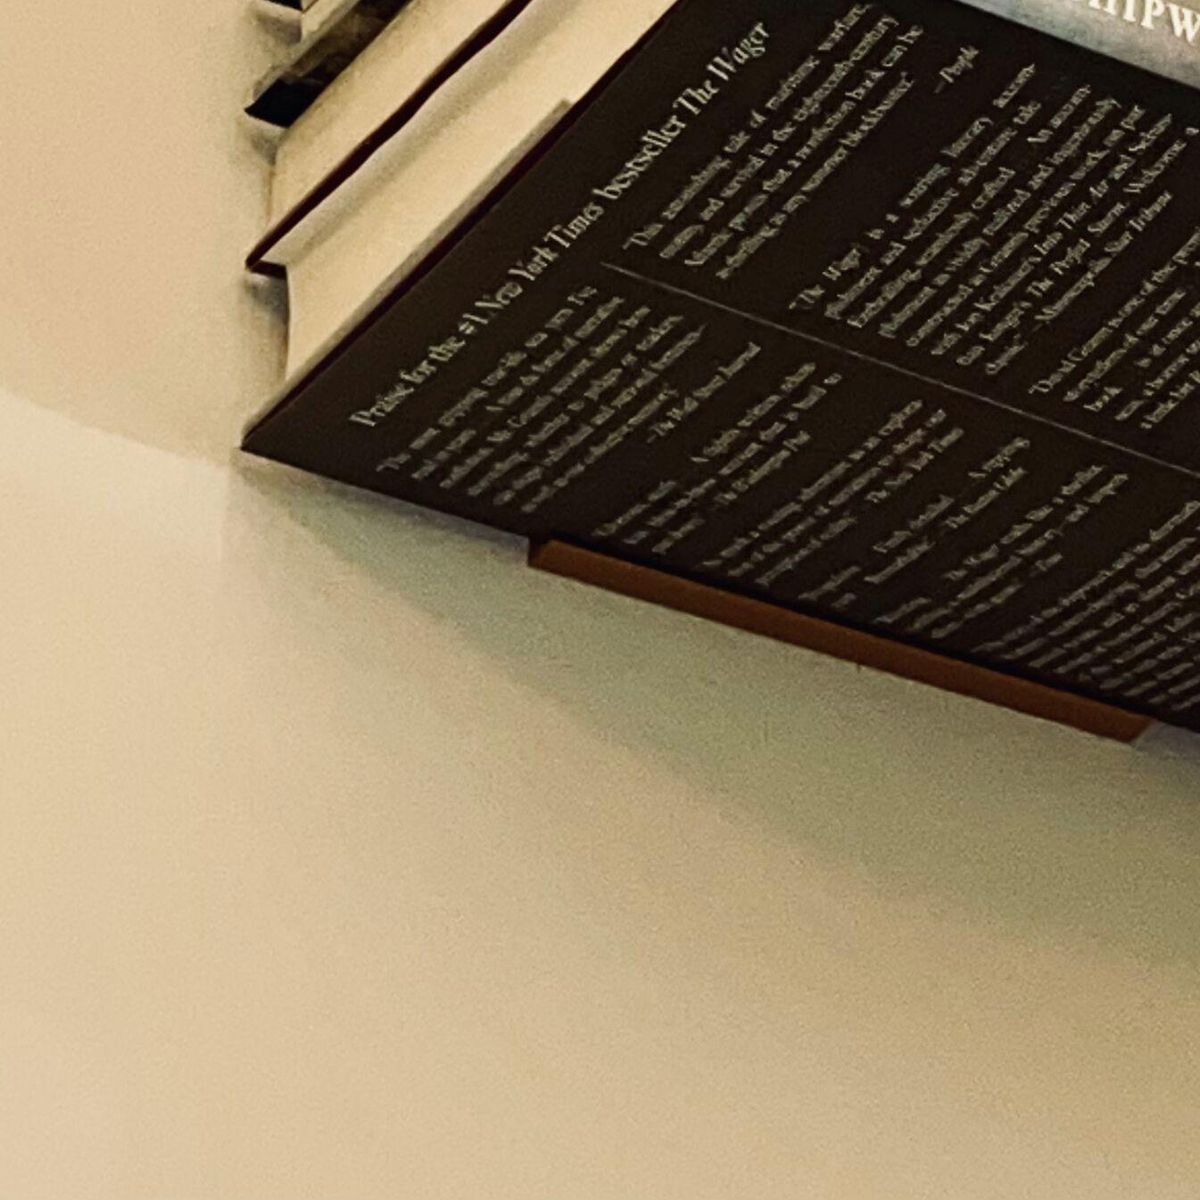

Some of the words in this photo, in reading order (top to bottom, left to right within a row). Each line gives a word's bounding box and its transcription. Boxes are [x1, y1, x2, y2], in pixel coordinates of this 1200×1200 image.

[349, 384, 414, 426] Praise
[398, 359, 436, 383] for
[427, 336, 465, 362] the
[457, 312, 488, 335] #1
[473, 281, 522, 309] New
[507, 246, 558, 280] York
[543, 202, 603, 248] Times
[592, 115, 685, 199] bestseller
[671, 79, 719, 115] The
[706, 22, 768, 80] Wager
